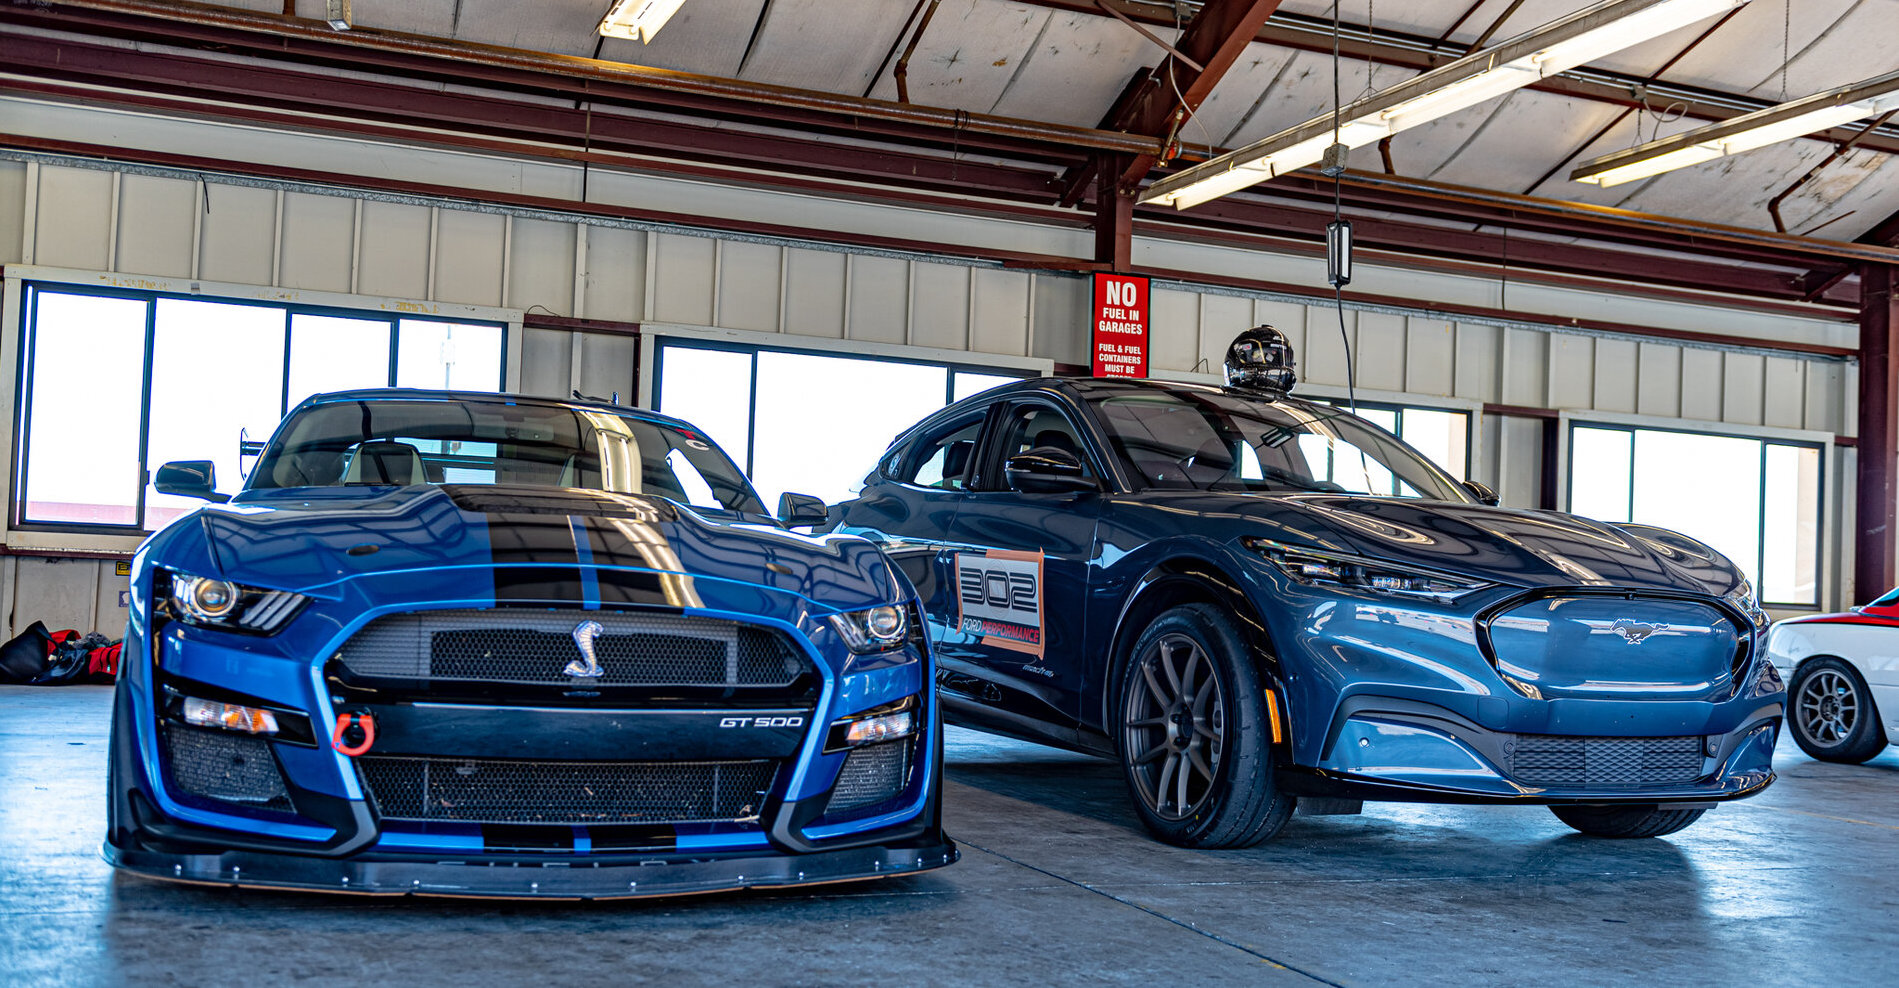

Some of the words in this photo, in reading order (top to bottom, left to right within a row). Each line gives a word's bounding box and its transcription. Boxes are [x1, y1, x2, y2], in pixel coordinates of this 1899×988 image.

[1106, 281, 1137, 307] NO
[1103, 307, 1127, 320] FUEL
[1129, 310, 1139, 321] IN
[1099, 321, 1142, 335] GARAGES
[1099, 343, 1116, 352] FUEL
[1117, 345, 1123, 353] &
[1124, 346, 1141, 354] FUEL
[1099, 353, 1141, 364] CONTAINERS
[1104, 363, 1124, 373] MUST
[1126, 365, 1135, 374] BE
[960, 567, 1038, 613] 302
[962, 618, 982, 632] FORD
[981, 621, 1040, 643] PERFORMANCE
[720, 717, 753, 728] GT
[754, 717, 803, 728] 500
